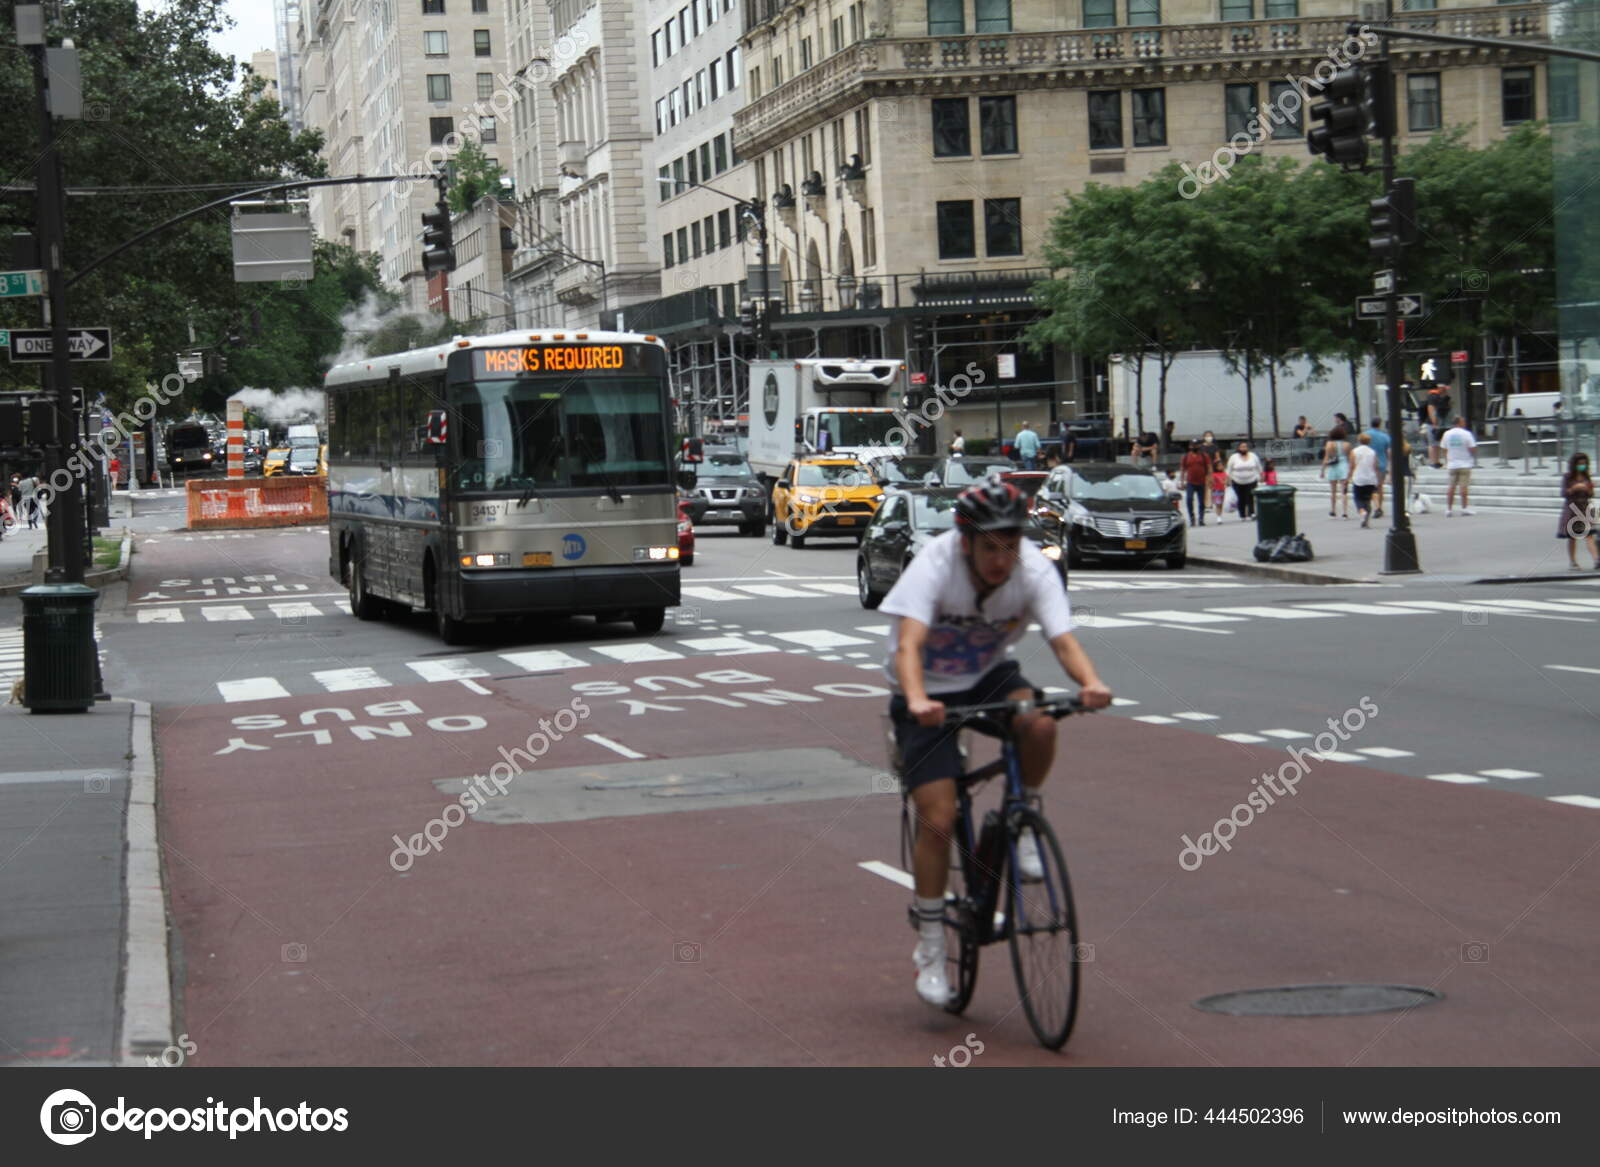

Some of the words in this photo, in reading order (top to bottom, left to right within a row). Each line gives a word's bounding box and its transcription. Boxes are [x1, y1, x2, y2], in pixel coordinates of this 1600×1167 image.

[11, 275, 25, 285] ST
[24, 340, 53, 352] ONE
[485, 349, 540, 371] MASKS
[545, 346, 623, 370] REQUIRED
[472, 505, 497, 517] 3413
[159, 574, 278, 587] BUS
[138, 584, 309, 600] ONLY
[571, 669, 775, 696] BUS
[616, 683, 891, 715] ONLY
[231, 700, 424, 730] BUS
[213, 715, 487, 755] ONLY
